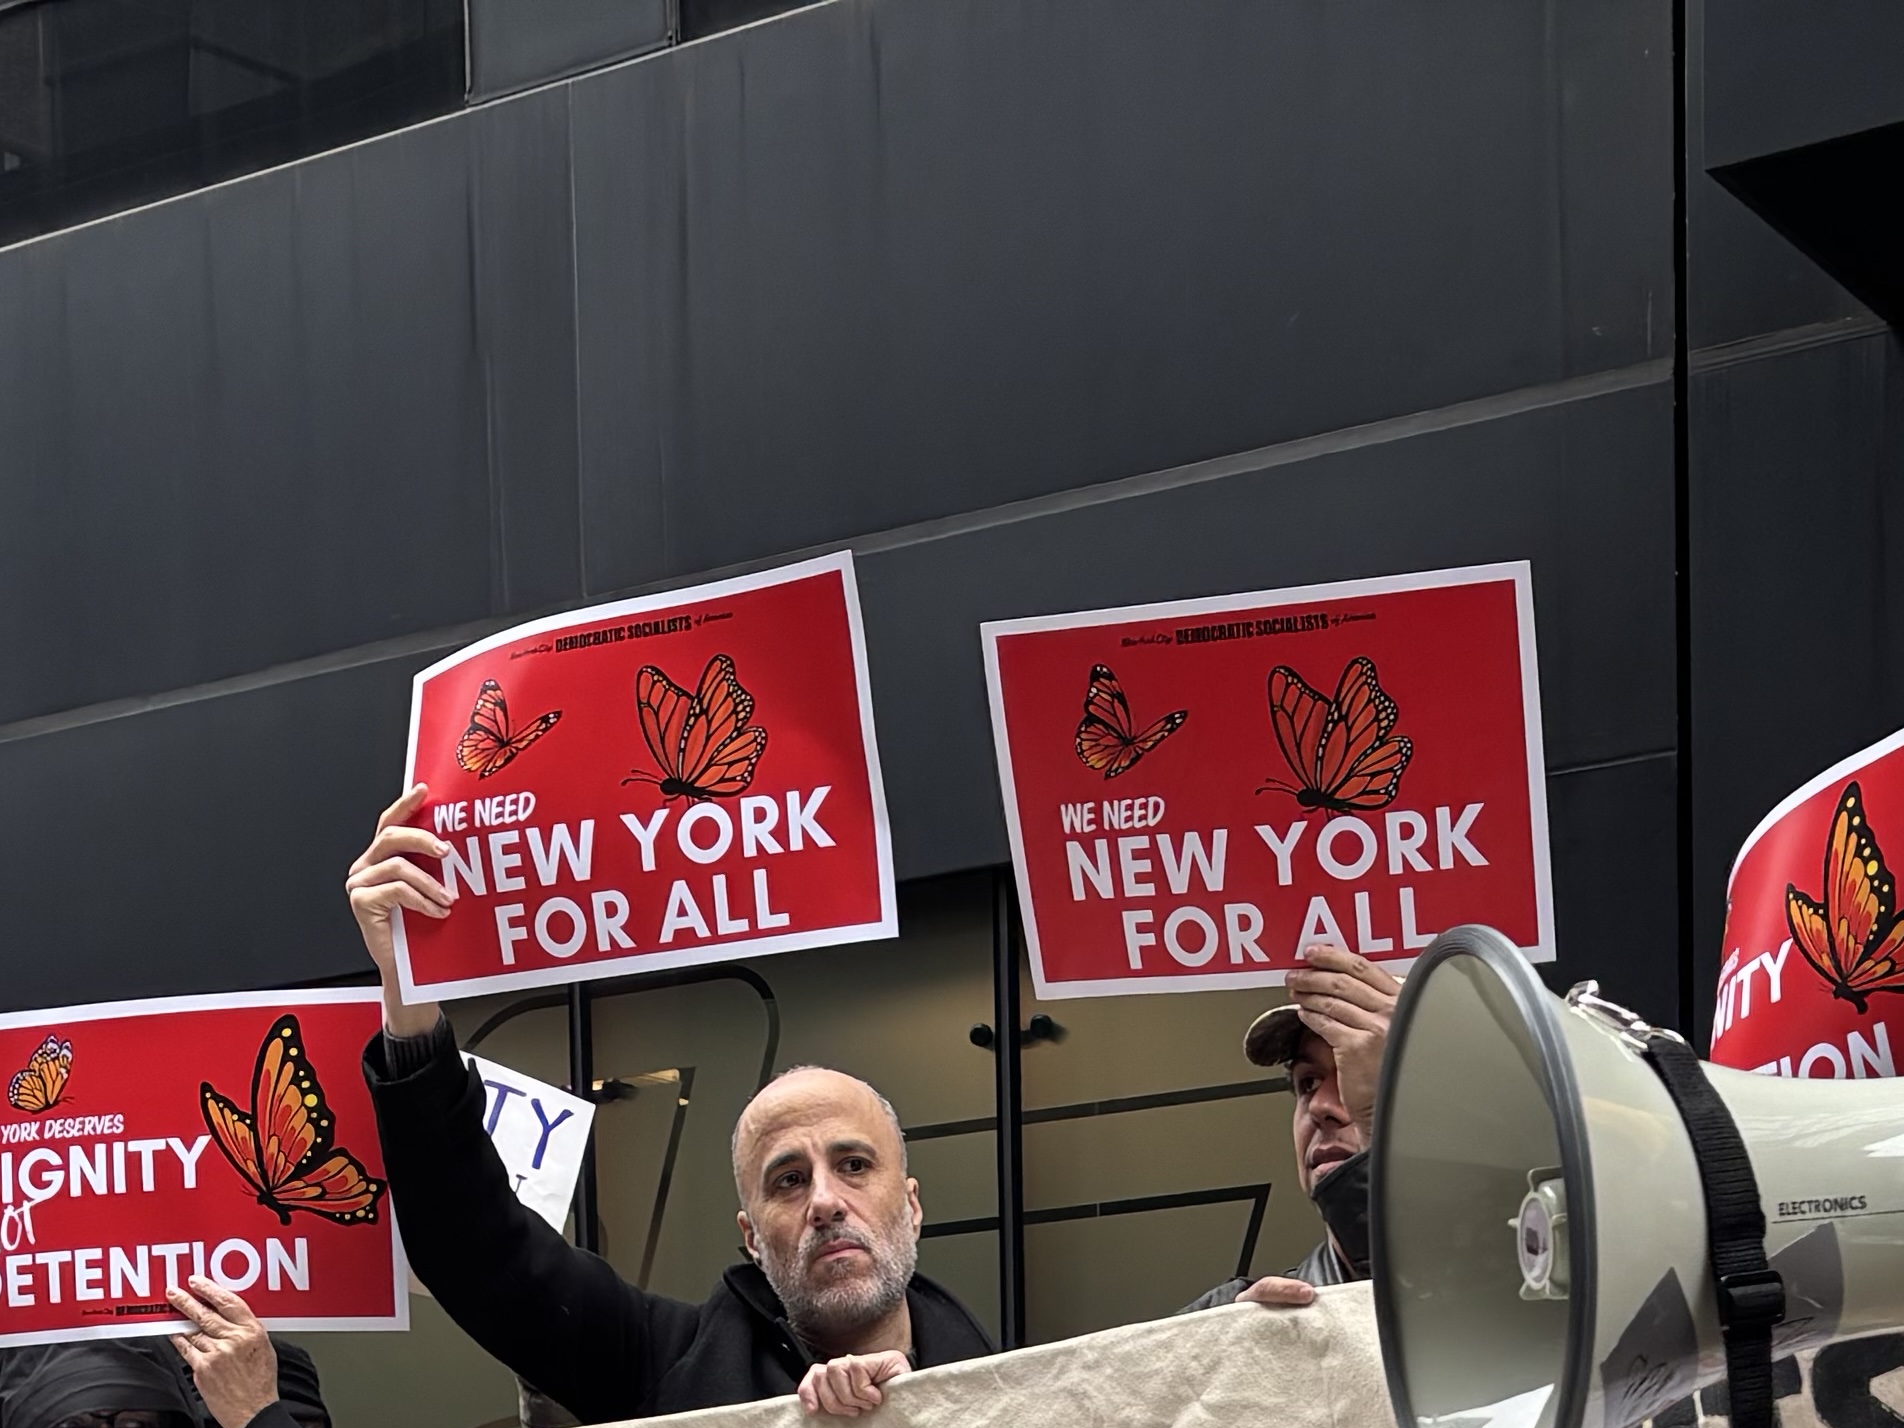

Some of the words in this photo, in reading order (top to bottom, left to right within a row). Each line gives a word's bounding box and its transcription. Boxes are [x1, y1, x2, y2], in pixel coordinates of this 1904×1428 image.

[434, 800, 468, 834] WE
[474, 791, 536, 826] NEED
[441, 818, 595, 900] NEW
[620, 784, 837, 873] YORK
[1061, 801, 1096, 835] WE
[1102, 796, 1165, 830] NEED
[1065, 828, 1228, 902] NEW
[1254, 802, 1490, 887] YORK
[494, 888, 638, 967] FOR
[659, 867, 791, 945] ALL
[1121, 902, 1271, 970] FOR
[1295, 886, 1441, 961] ALL
[0, 1120, 41, 1144] YORK
[44, 1113, 124, 1140] DESERVES
[1778, 1195, 1867, 1216] ELECTRONICS
